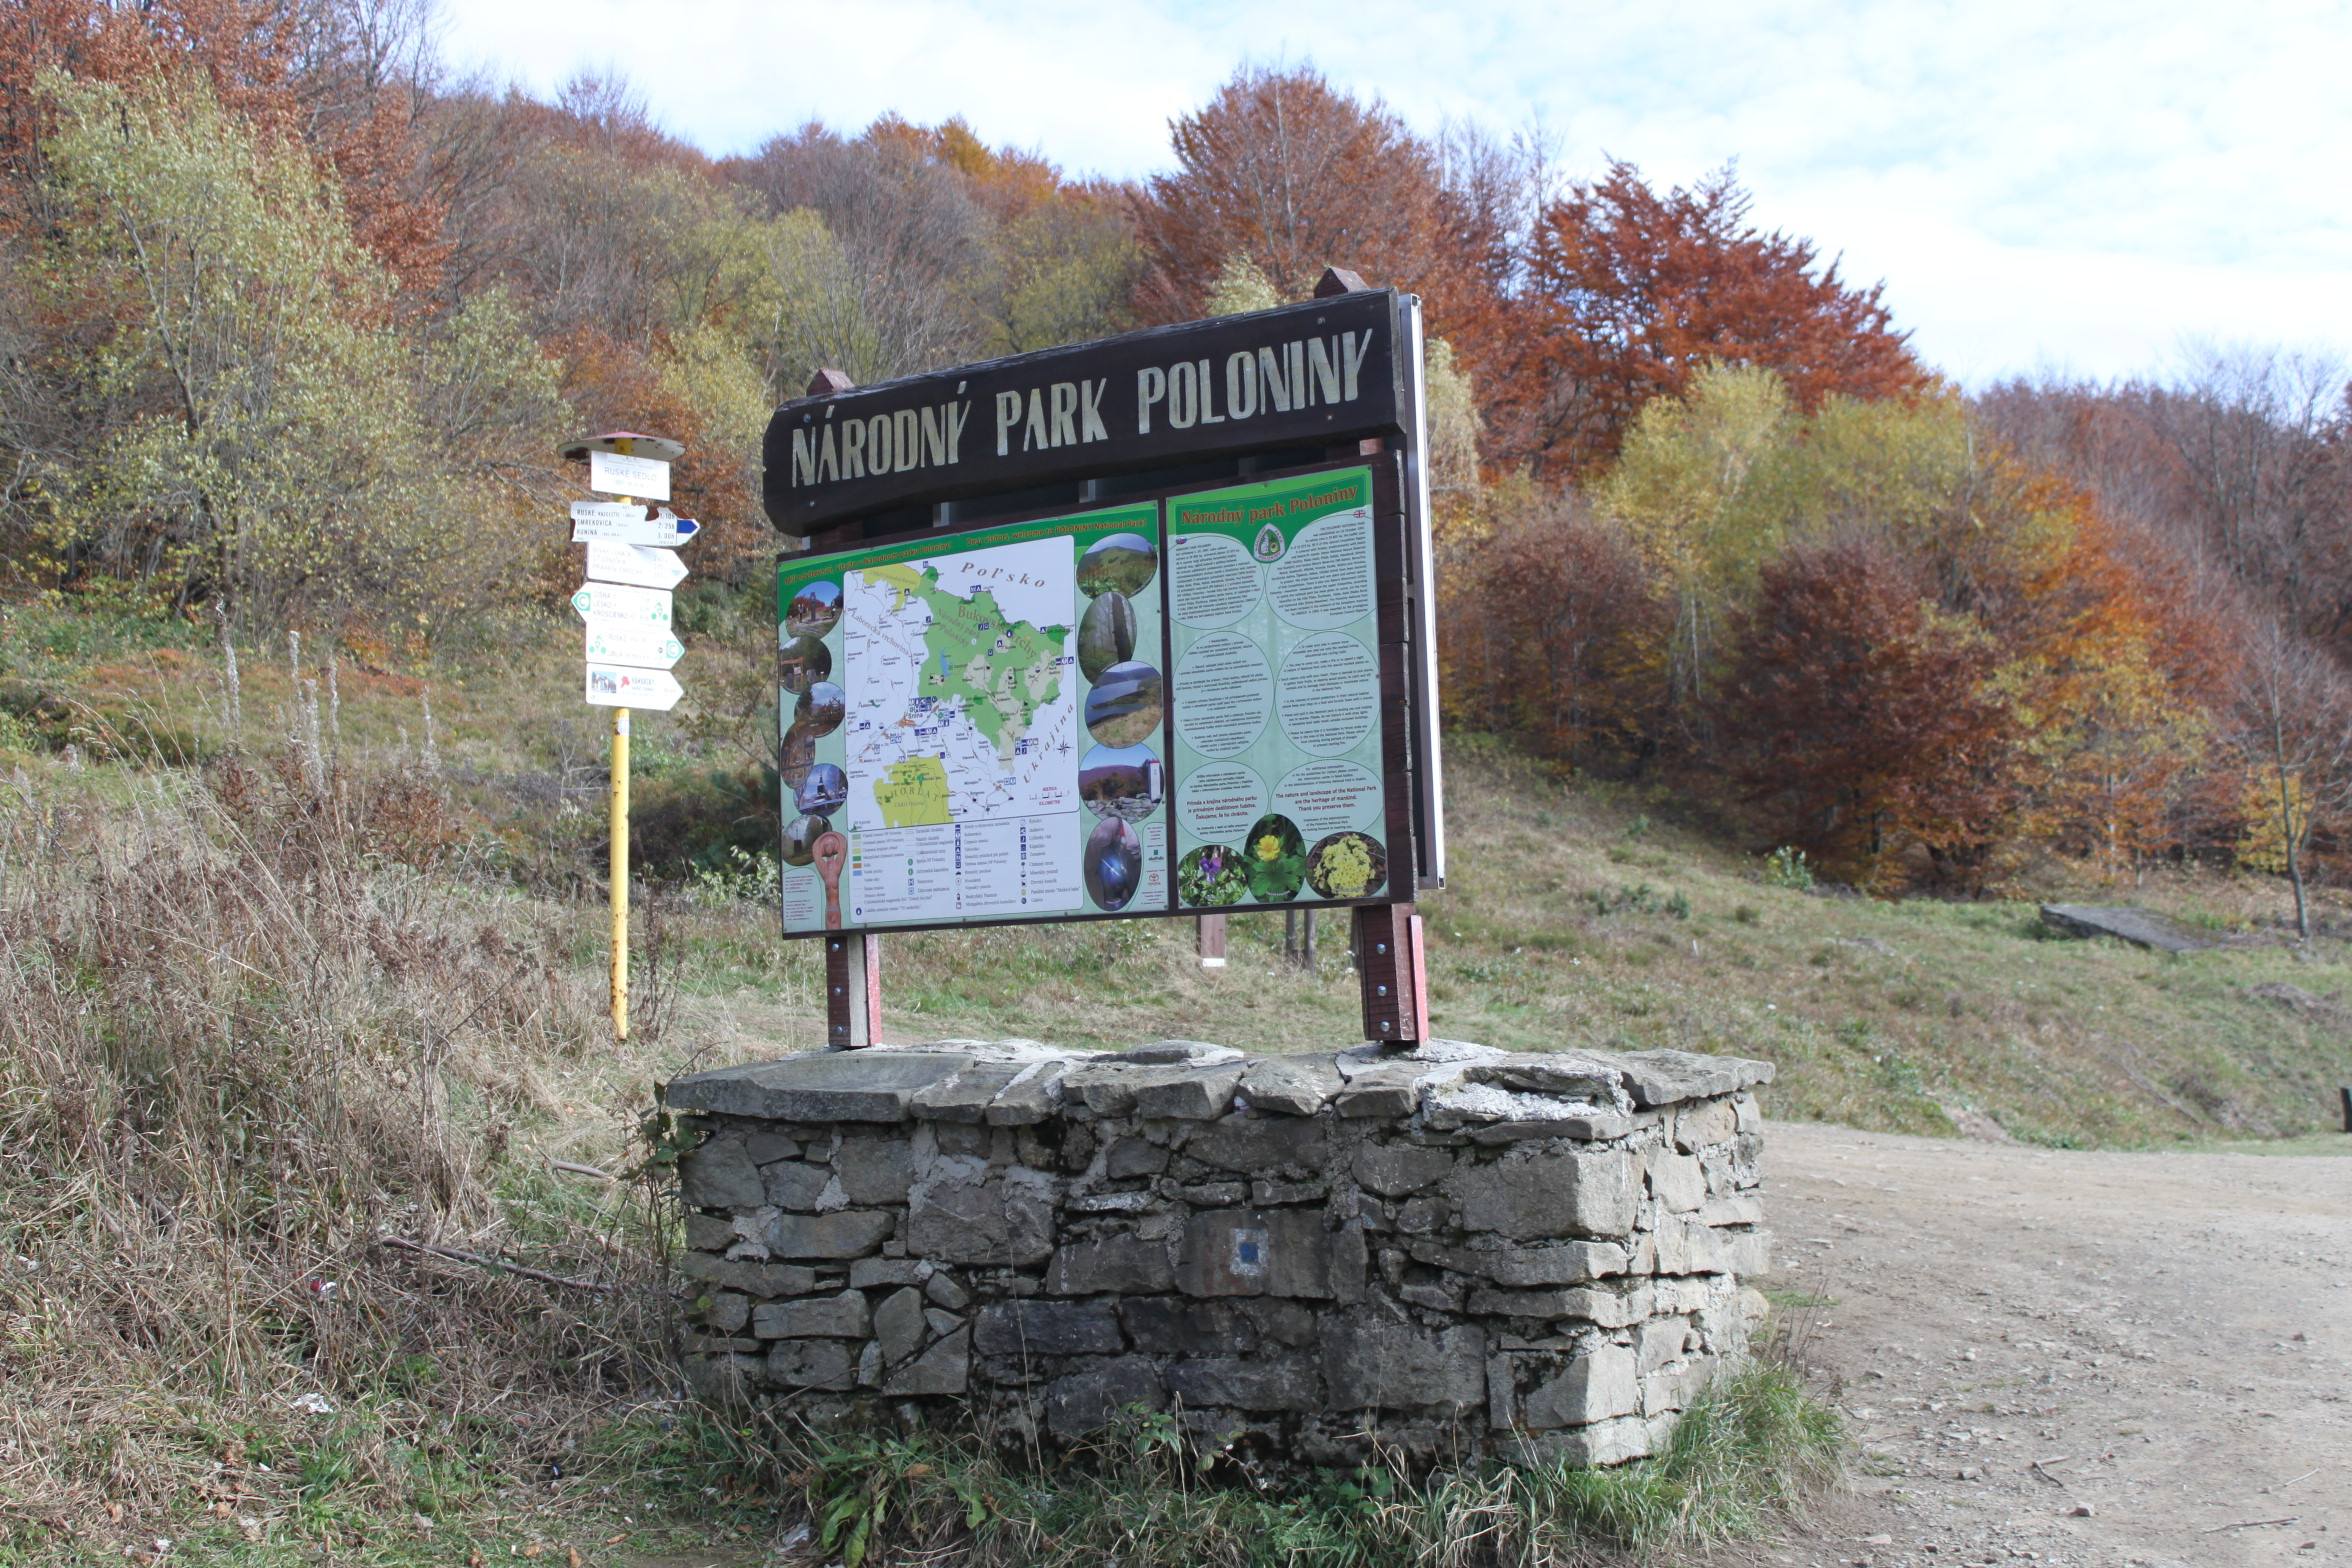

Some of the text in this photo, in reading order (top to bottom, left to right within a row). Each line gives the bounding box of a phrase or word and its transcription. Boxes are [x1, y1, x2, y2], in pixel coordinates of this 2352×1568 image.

[792, 328, 1373, 488] NÁRODNÝ PARK POLONINY
[1248, 503, 1286, 524] park
[1289, 485, 1359, 513] Poloniny
[960, 562, 1045, 588] Poľsko
